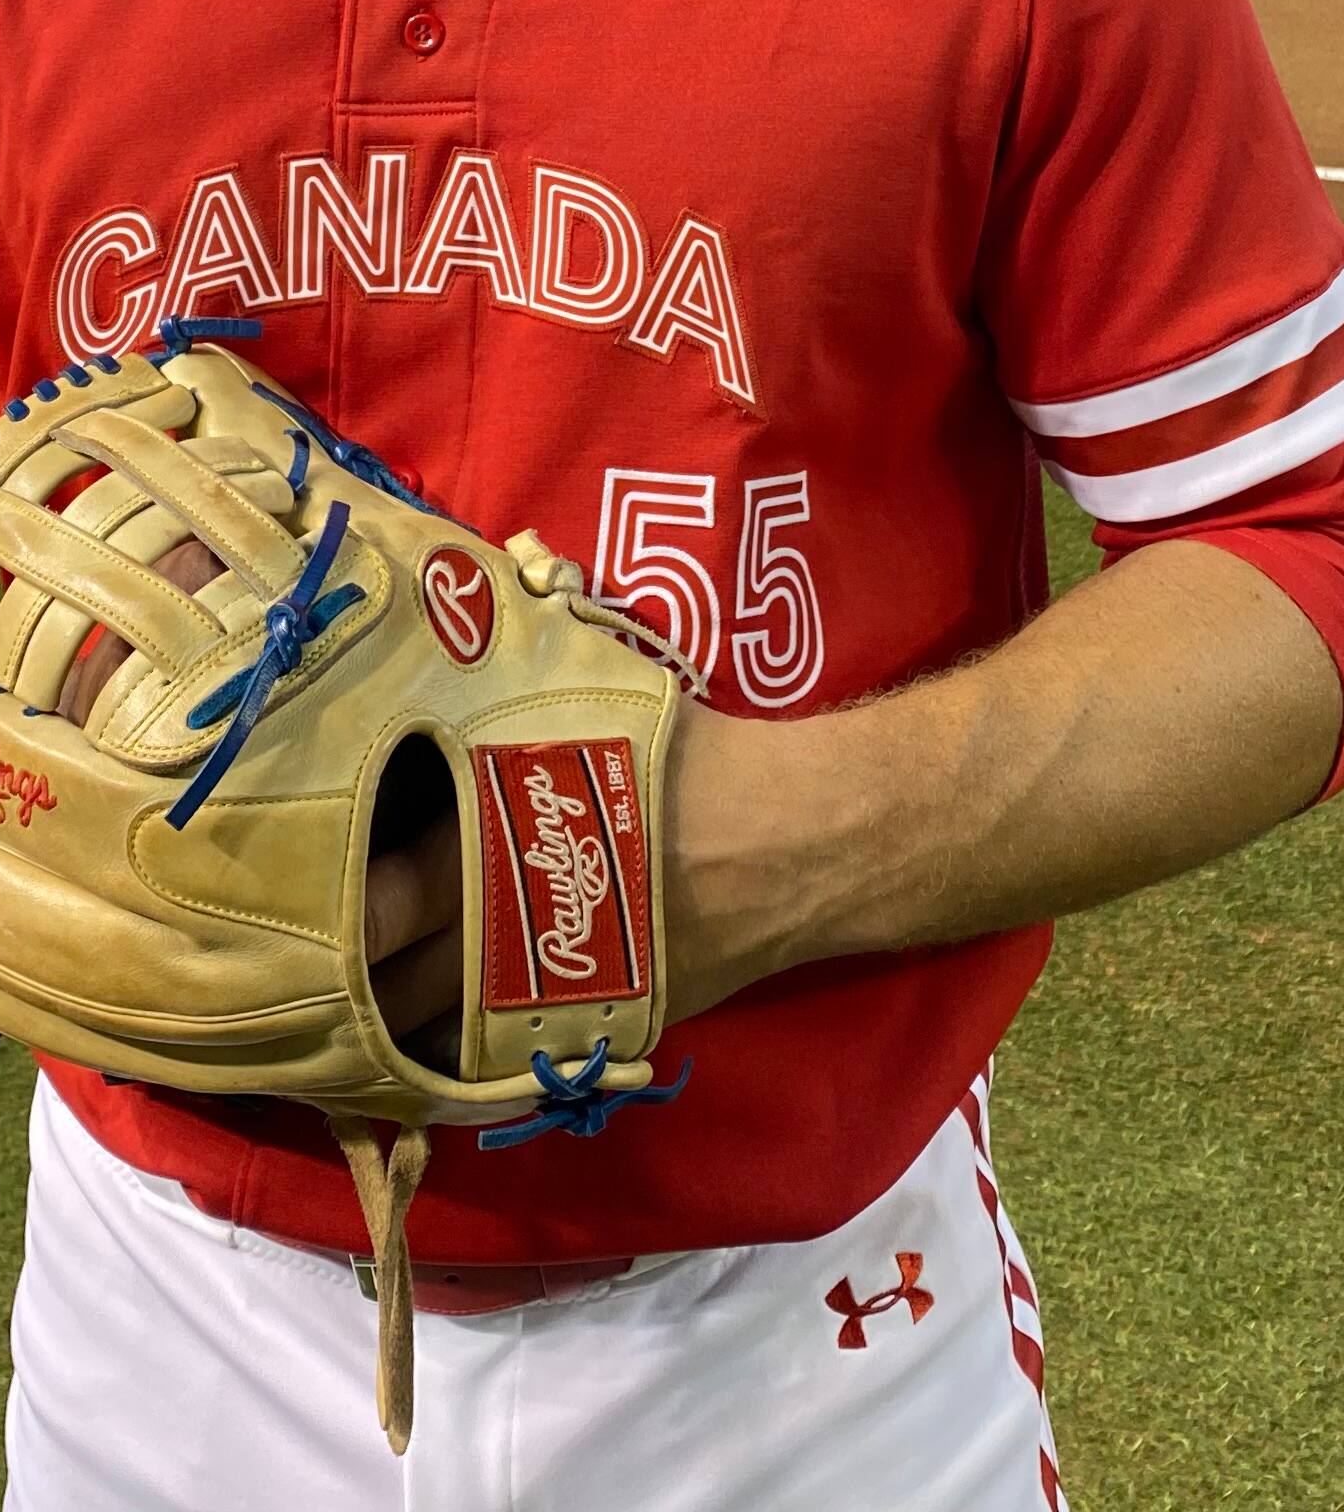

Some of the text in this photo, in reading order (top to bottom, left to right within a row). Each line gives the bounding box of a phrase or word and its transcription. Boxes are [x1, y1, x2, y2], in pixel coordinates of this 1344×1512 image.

[57, 151, 758, 406] CANADA
[590, 467, 825, 709] 55
[523, 763, 598, 981] Rawlings
[603, 750, 633, 835] Est. 1887
